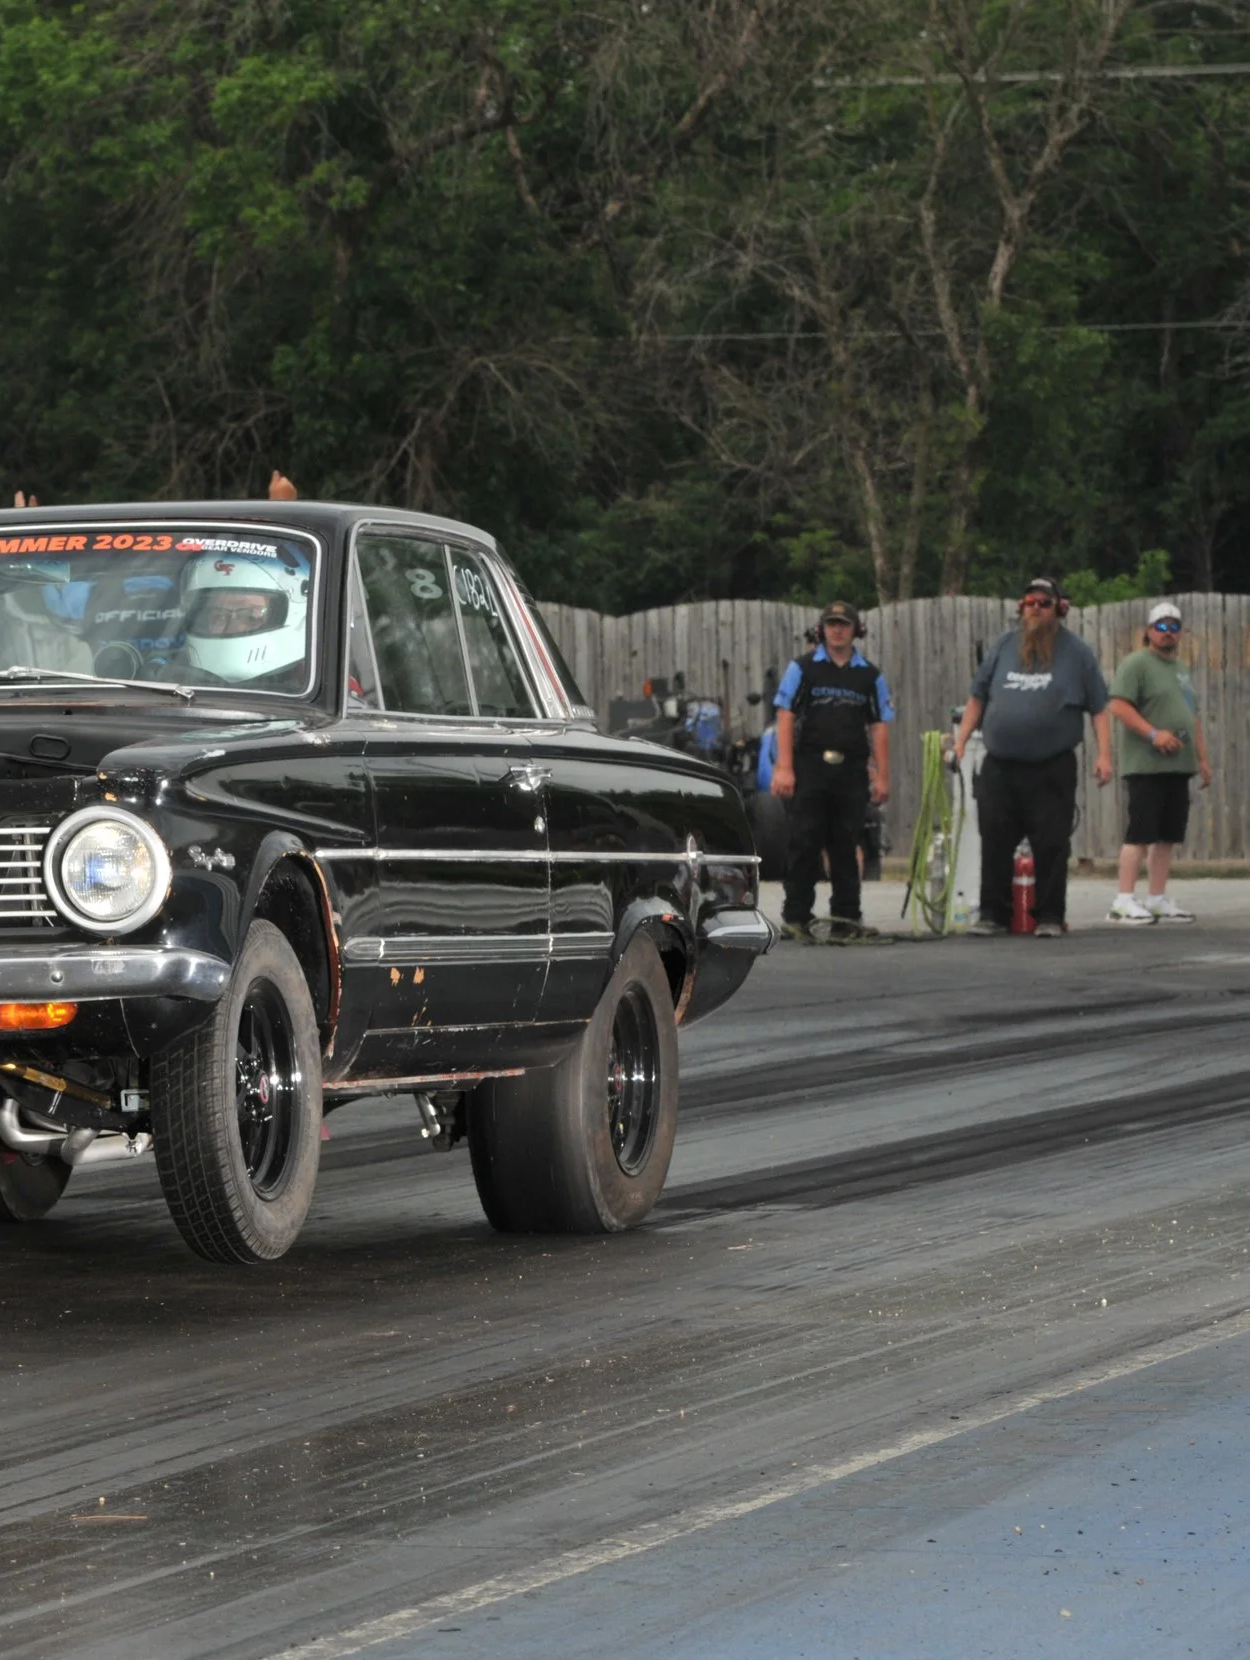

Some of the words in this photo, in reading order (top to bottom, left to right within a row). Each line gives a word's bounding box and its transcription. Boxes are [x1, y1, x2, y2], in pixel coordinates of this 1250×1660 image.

[92, 534, 173, 550] 2023
[182, 537, 278, 553] OVERDRIVE
[230, 546, 278, 558] VENDORS
